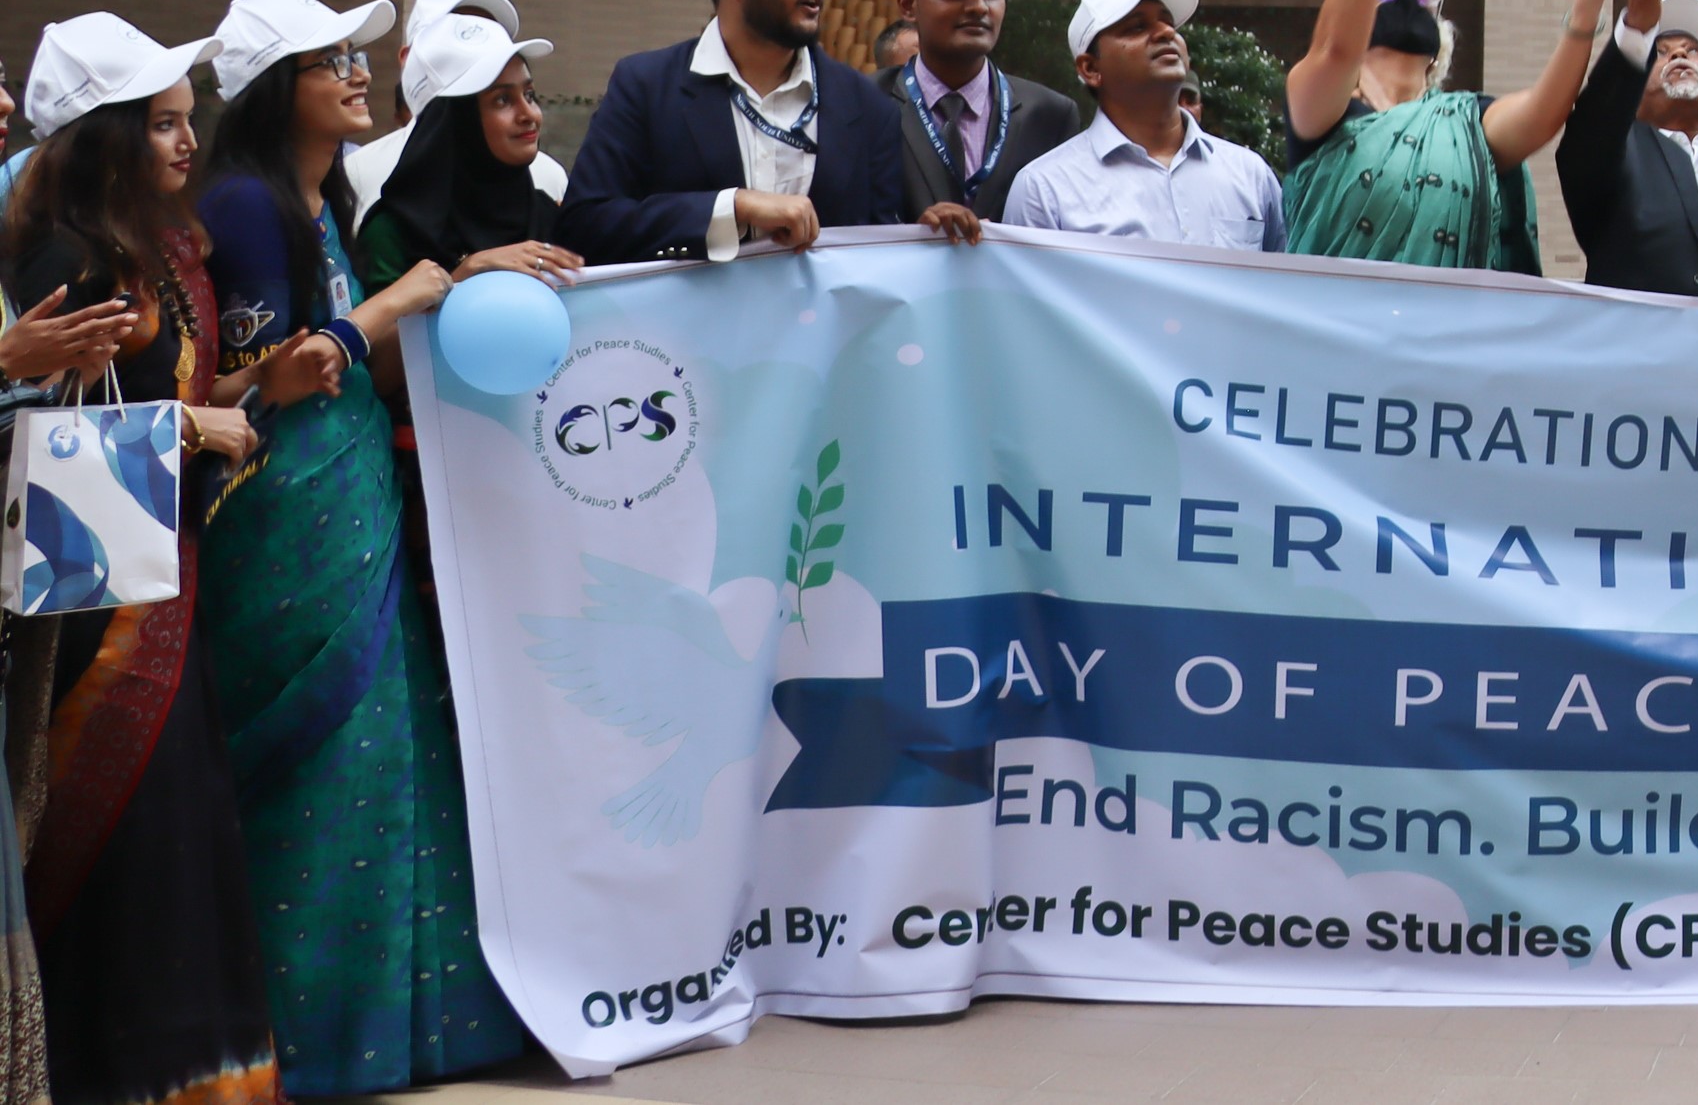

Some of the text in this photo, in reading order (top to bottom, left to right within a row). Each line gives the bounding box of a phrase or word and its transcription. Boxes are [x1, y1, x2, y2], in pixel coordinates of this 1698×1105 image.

[545, 339, 672, 388] Center for Peace Studies
[532, 409, 546, 454] Studies
[554, 390, 678, 457] CPS
[637, 381, 700, 502] Center for Peace Studies
[540, 455, 566, 489] Peace
[580, 494, 618, 511] Center
[924, 639, 1106, 709] DAY
[1174, 655, 1318, 720] OF
[995, 764, 1138, 835] End
[1170, 779, 1496, 857] Racism.
[582, 907, 772, 1029] Orgaed
[785, 906, 847, 958] By:
[892, 890, 1057, 950] Cener
[1071, 885, 1153, 940] for
[1167, 899, 1351, 949] Peace
[1365, 911, 1592, 958] Studies
